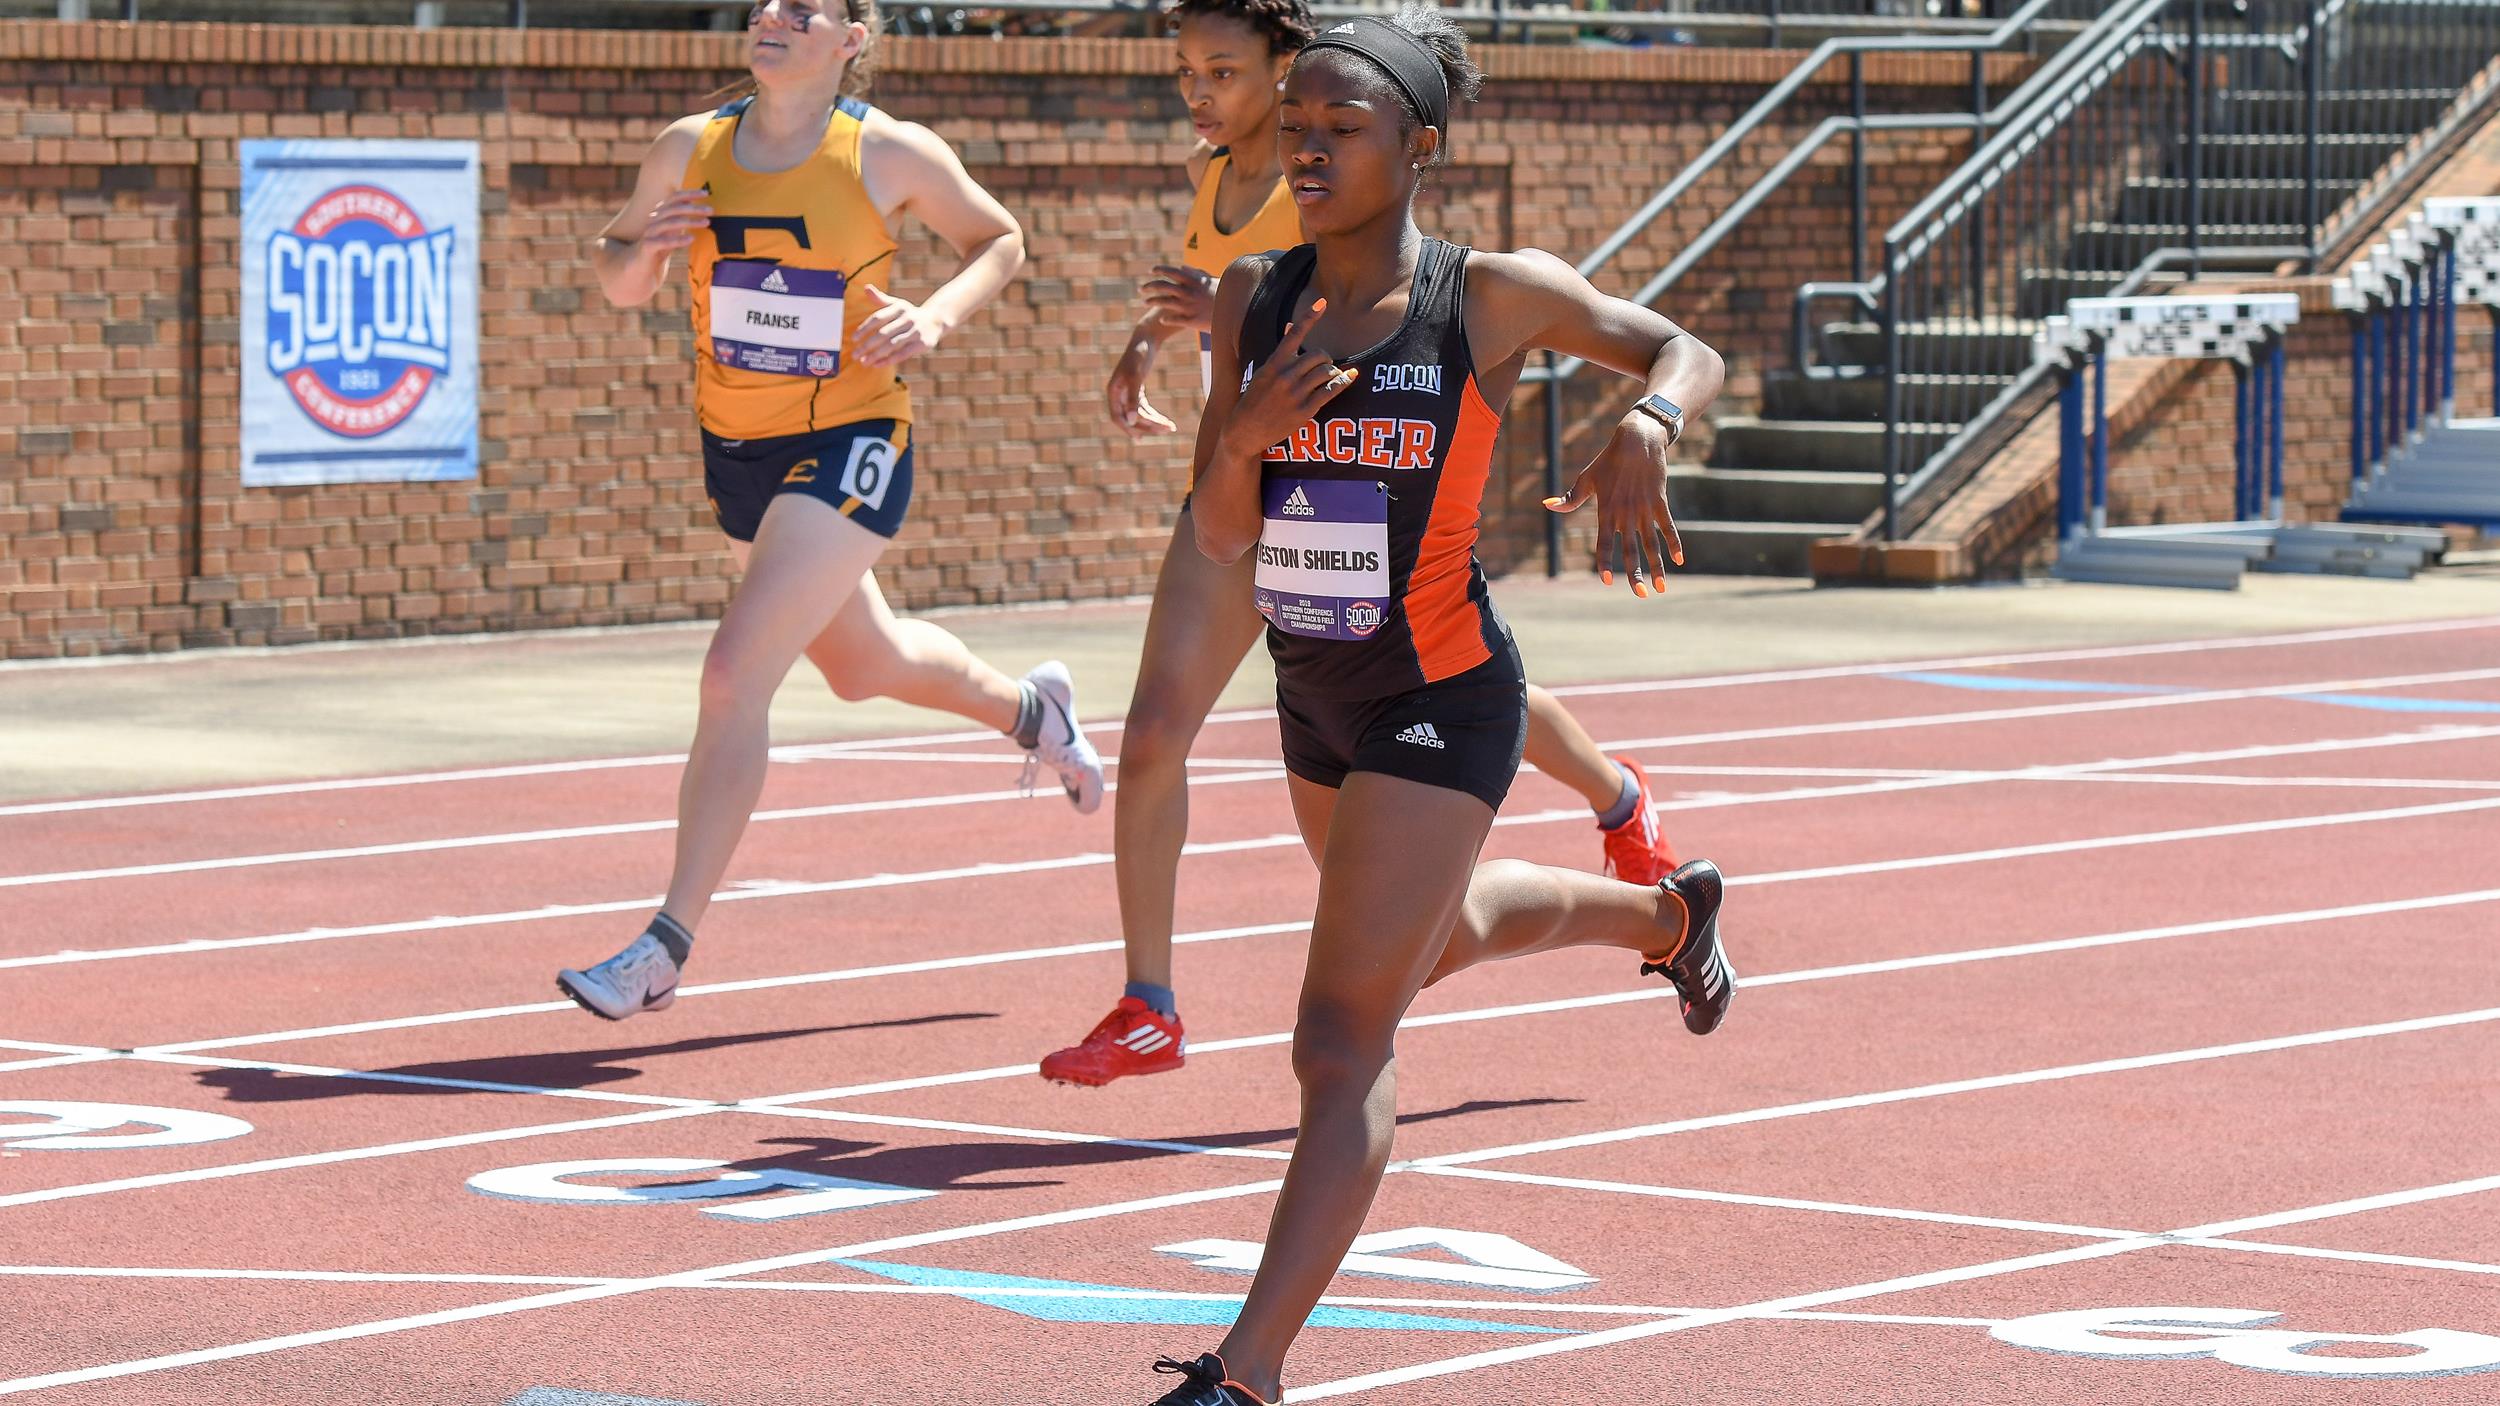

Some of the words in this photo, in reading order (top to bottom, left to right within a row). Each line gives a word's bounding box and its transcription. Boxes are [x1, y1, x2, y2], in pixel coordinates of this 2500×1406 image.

[304, 192, 413, 235] SOUTHERN
[269, 229, 452, 370] SOCON
[746, 310, 800, 330] FRANSE
[339, 369, 380, 390] 1921
[1371, 363, 1442, 395] SOCON
[295, 371, 422, 428] CONFERENCE
[1261, 417, 1437, 469] RCER
[854, 442, 887, 496] 6
[1282, 504, 1315, 516] adidas
[1303, 548, 1379, 572] SHIELDS
[1281, 604, 1303, 614] SOUTHERN
[1303, 607, 1334, 617] CONFERENCE
[1321, 617, 1335, 625] FIELD
[1346, 606, 1381, 627] SOCON
[1290, 620, 1326, 632] CHAMPIONSHIPS
[1395, 732, 1445, 749] adidas
[465, 1157, 942, 1222] 5
[1150, 1226, 1602, 1294] 4
